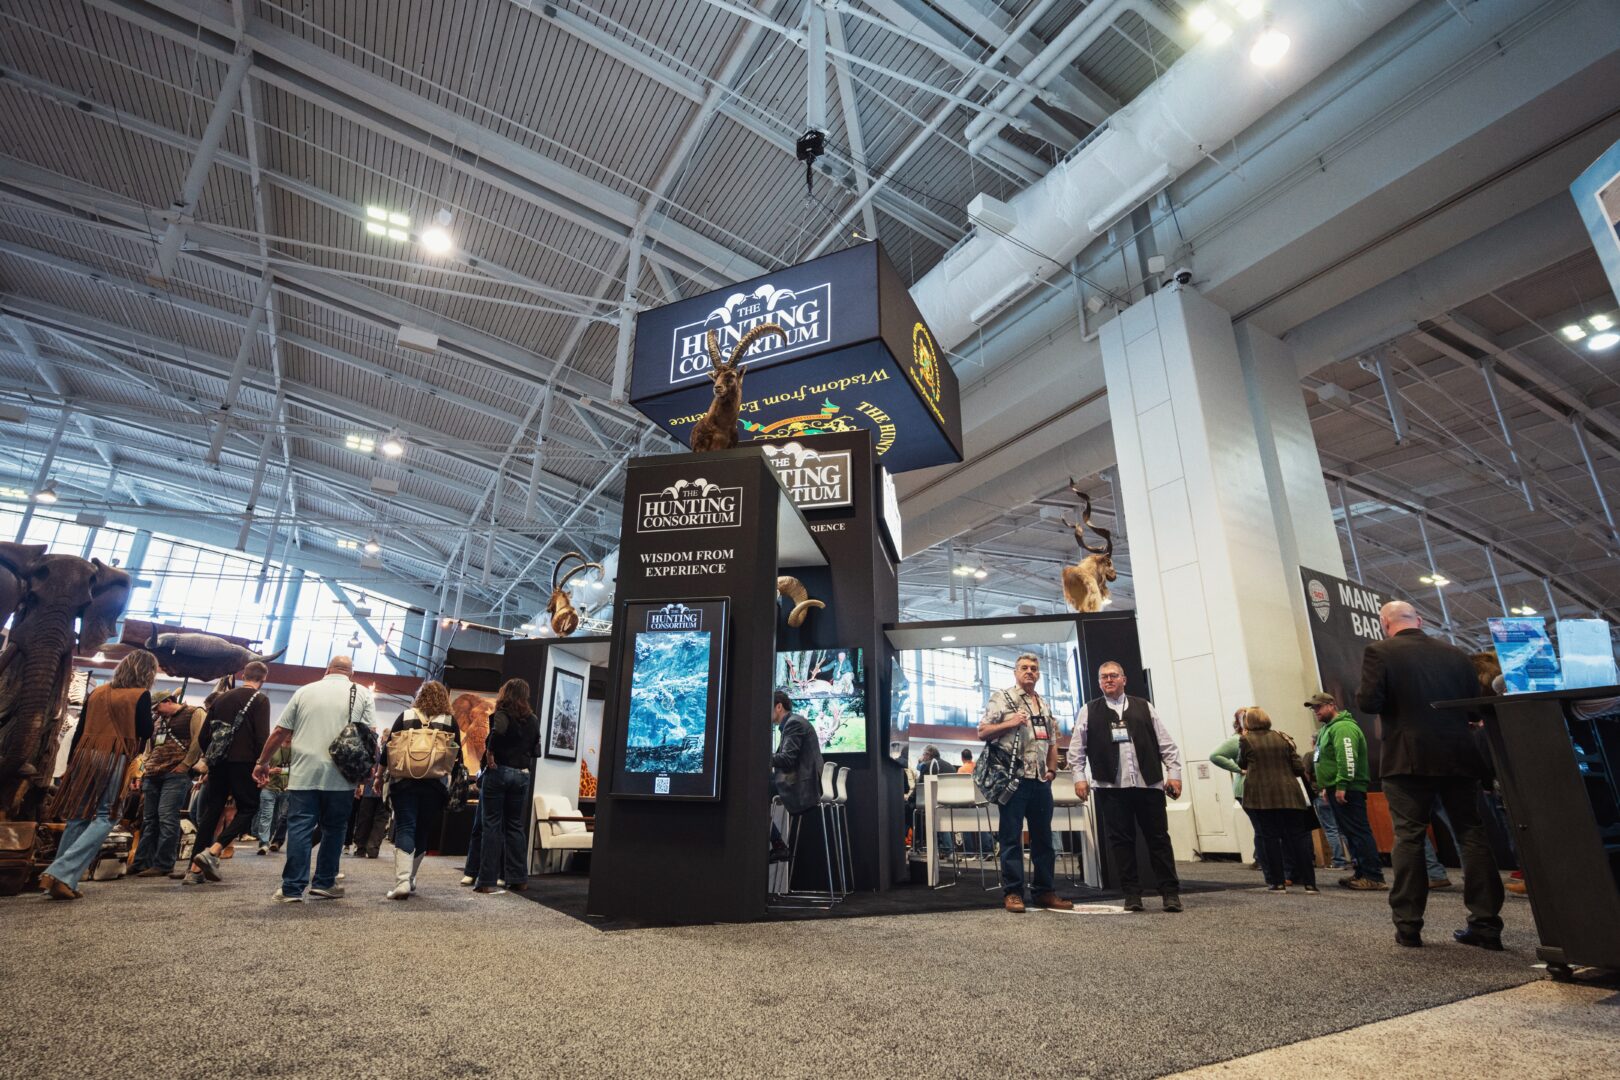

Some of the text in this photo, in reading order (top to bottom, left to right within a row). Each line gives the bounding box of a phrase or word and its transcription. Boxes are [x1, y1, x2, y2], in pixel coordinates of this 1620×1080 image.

[736, 303, 761, 317] THE
[679, 322, 820, 375] COSRTIUM
[809, 368, 892, 395] Wisdom
[762, 385, 808, 406] from
[855, 401, 891, 424] THE
[644, 496, 736, 517] HUNTING
[643, 512, 735, 529] CONSORTIUM
[640, 549, 734, 564] WISDOM FROM
[645, 563, 727, 577] EXPERIENCE
[1338, 582, 1381, 616] MANE
[650, 622, 697, 630] CONSORTIUM
[652, 613, 698, 624] HUNTING
[1350, 612, 1383, 641] BAR
[1343, 737, 1355, 777] CARHARTT
